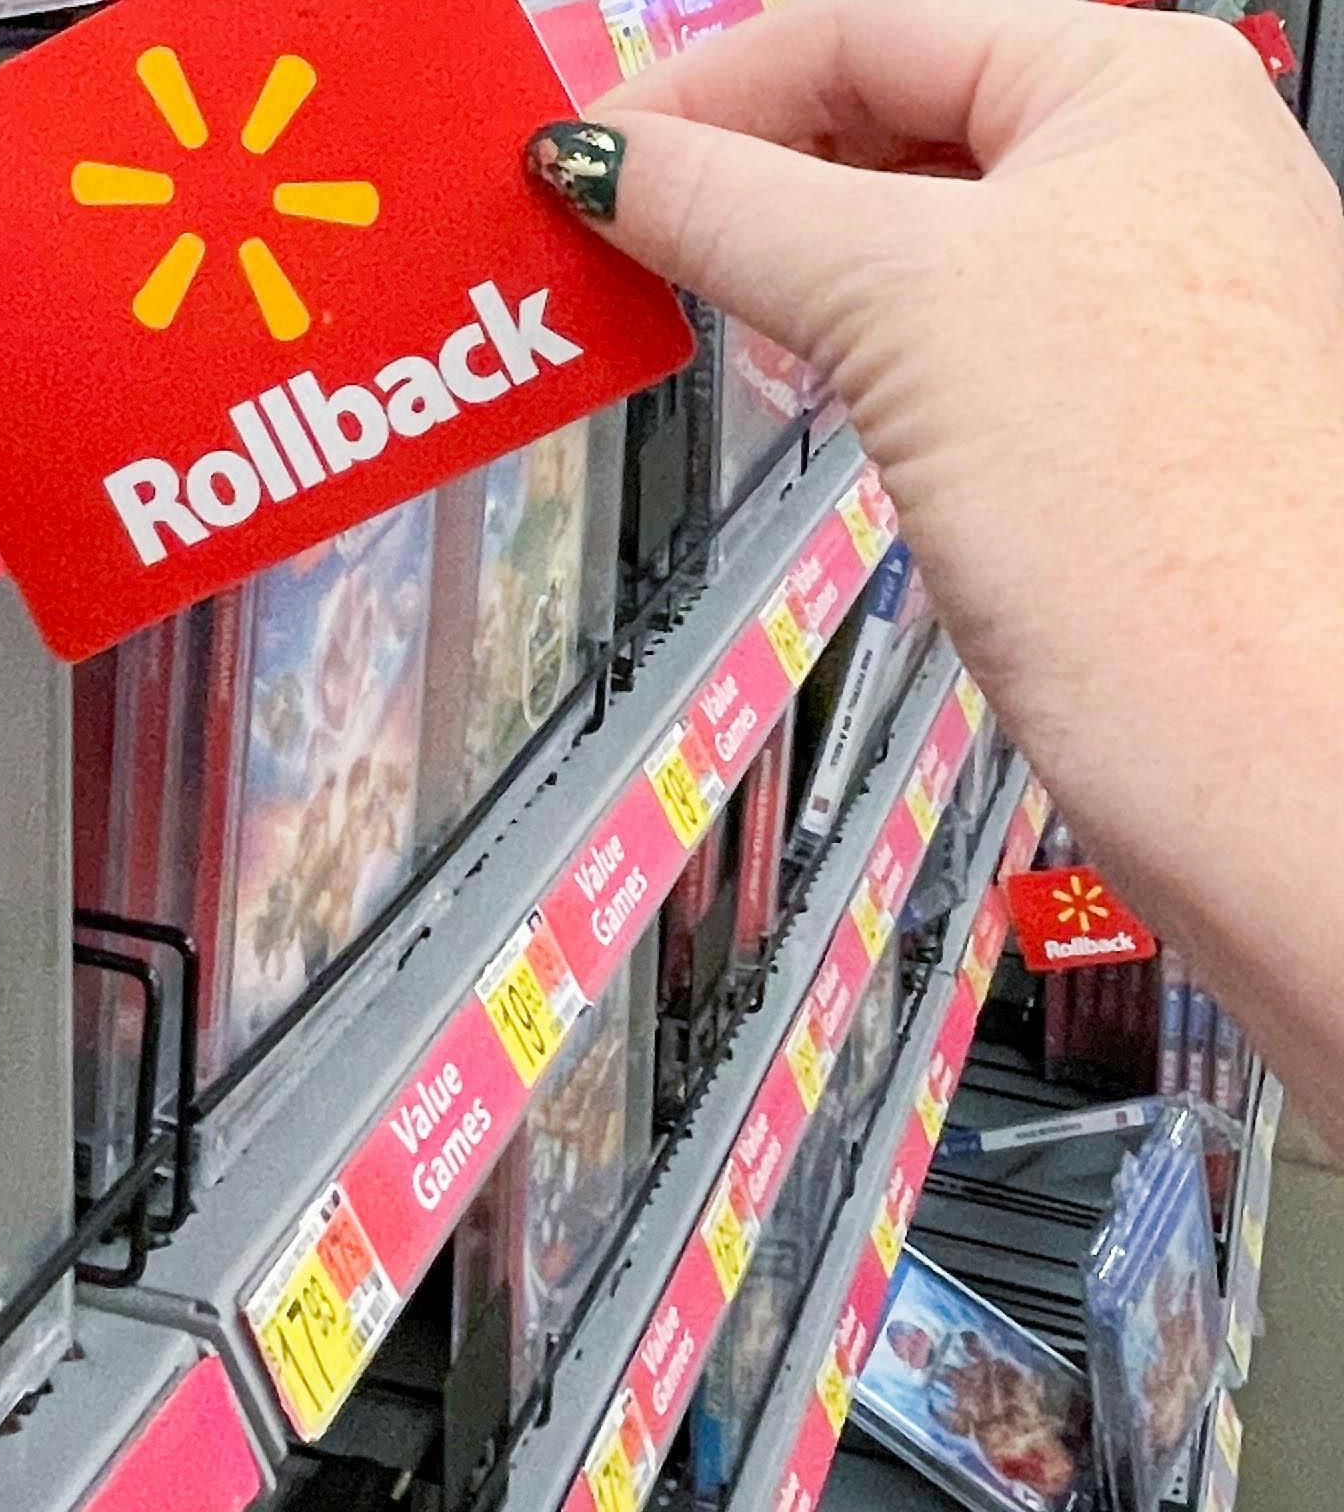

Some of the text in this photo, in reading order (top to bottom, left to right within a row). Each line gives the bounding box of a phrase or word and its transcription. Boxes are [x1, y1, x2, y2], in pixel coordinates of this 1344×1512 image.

[102, 279, 584, 567] Rollback
[574, 834, 626, 903] Value
[590, 865, 649, 947] Games
[1044, 931, 1137, 961] Rollback
[389, 1061, 464, 1155] Value
[411, 1096, 493, 1211] Games
